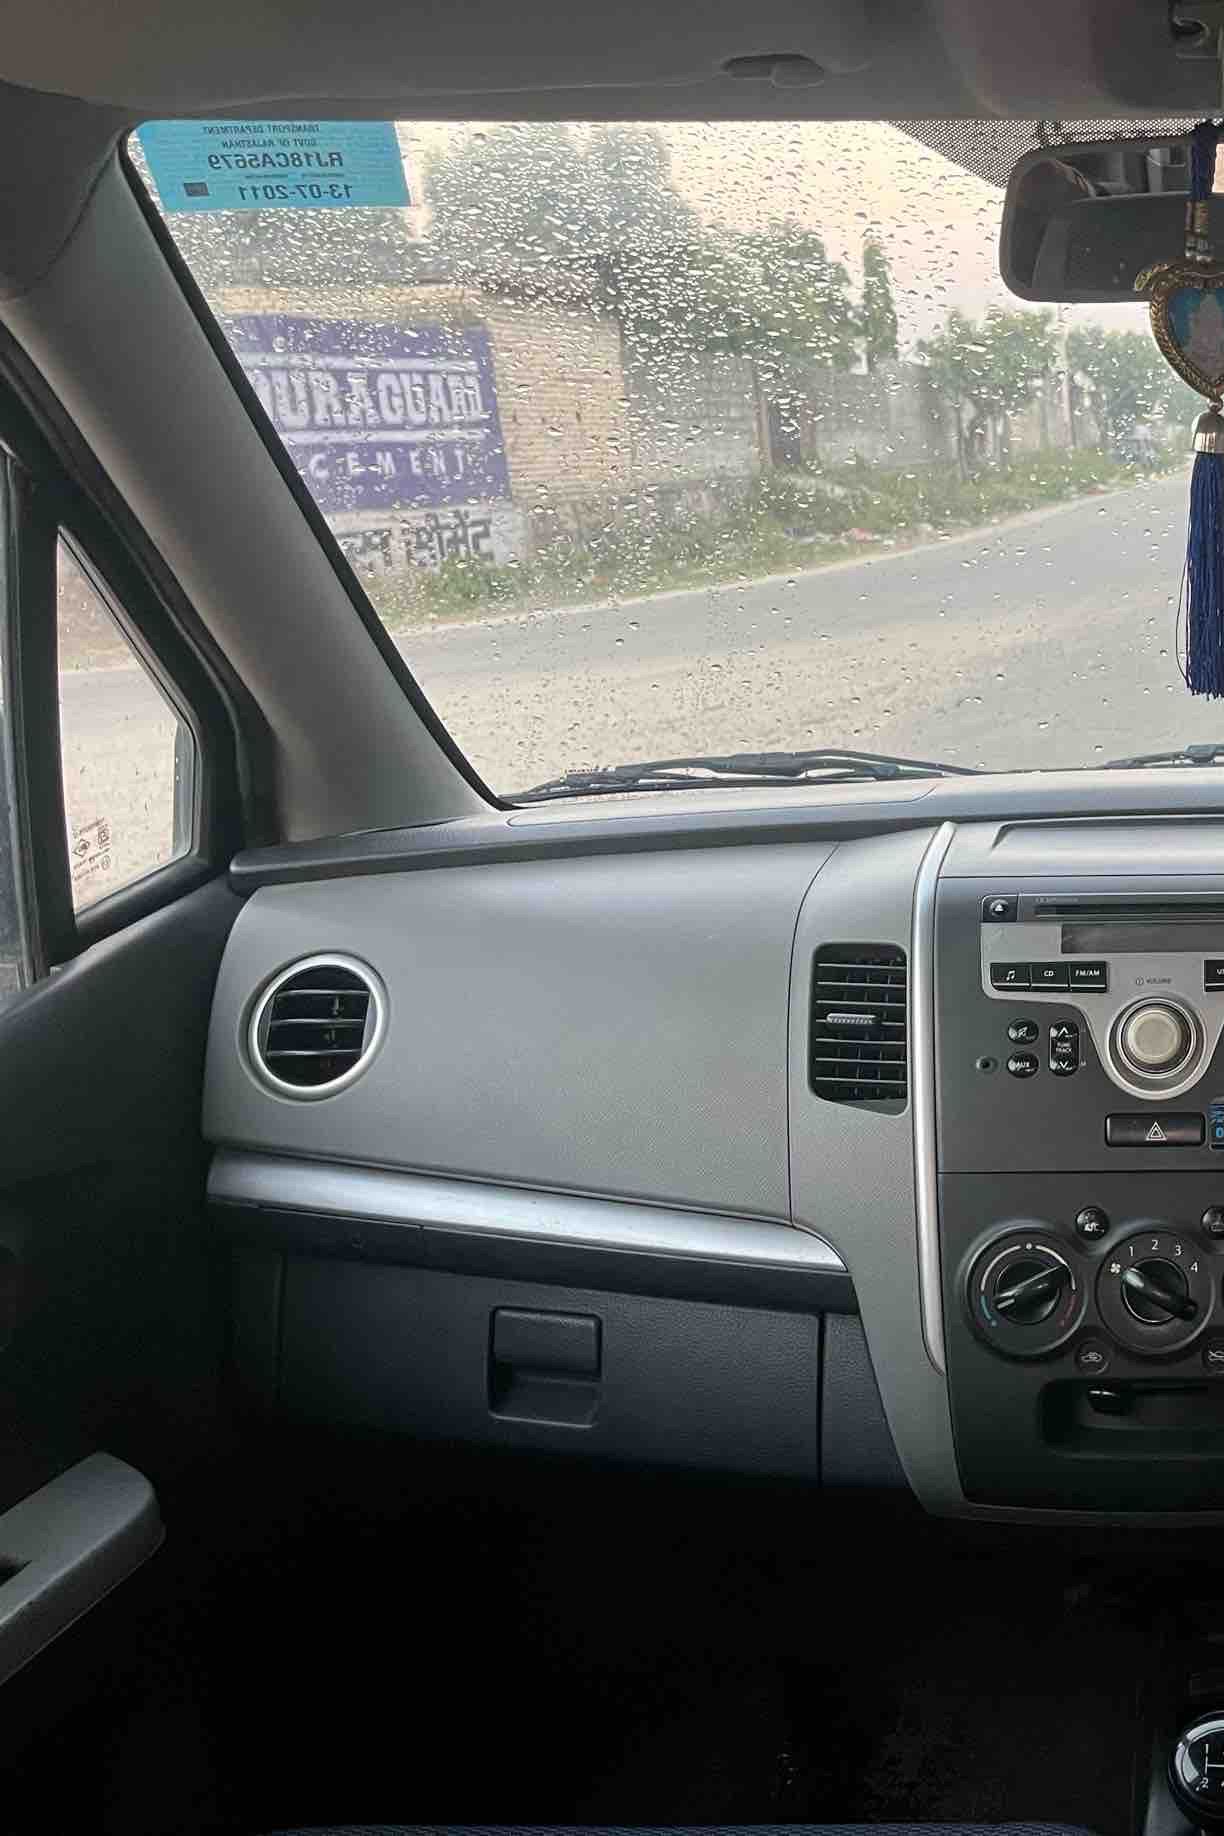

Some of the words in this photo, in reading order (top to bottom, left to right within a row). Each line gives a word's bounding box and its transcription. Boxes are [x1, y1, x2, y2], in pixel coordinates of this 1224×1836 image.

[1043, 969, 1055, 978] CD
[1075, 969, 1100, 977] FM/AM
[1151, 1239, 1160, 1251] 2
[1128, 1246, 1135, 1257] 1
[1174, 1245, 1183, 1257] 3
[1190, 1262, 1200, 1273] 4
[1200, 1778, 1209, 1789] 2
